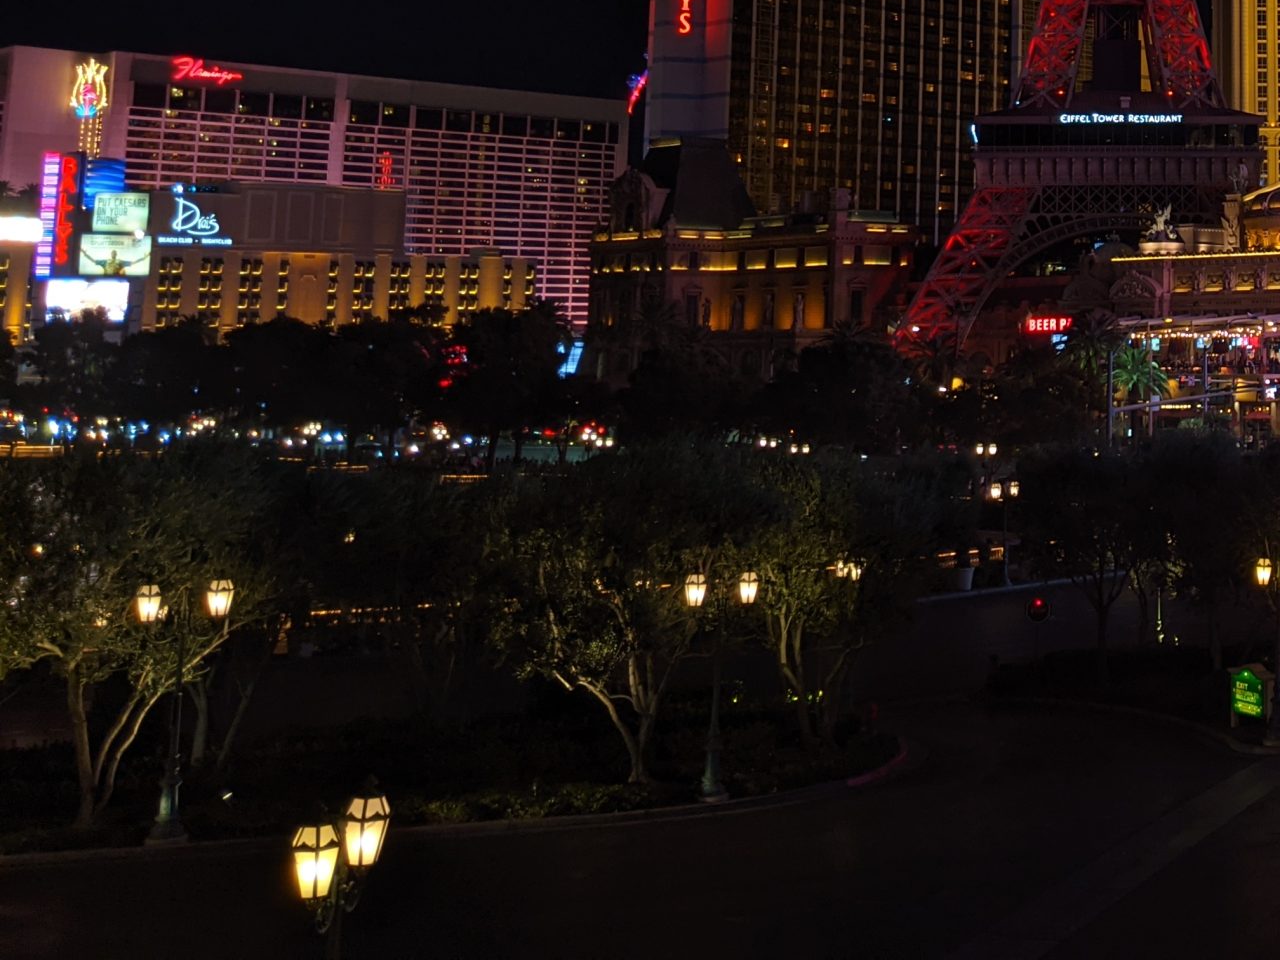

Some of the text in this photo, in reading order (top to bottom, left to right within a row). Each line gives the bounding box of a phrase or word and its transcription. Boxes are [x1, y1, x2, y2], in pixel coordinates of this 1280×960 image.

[172, 56, 242, 84] Flamingo
[1060, 113, 1182, 123] EIFFEL TOWER RESTAURANT
[1029, 319, 1057, 331] BEER
